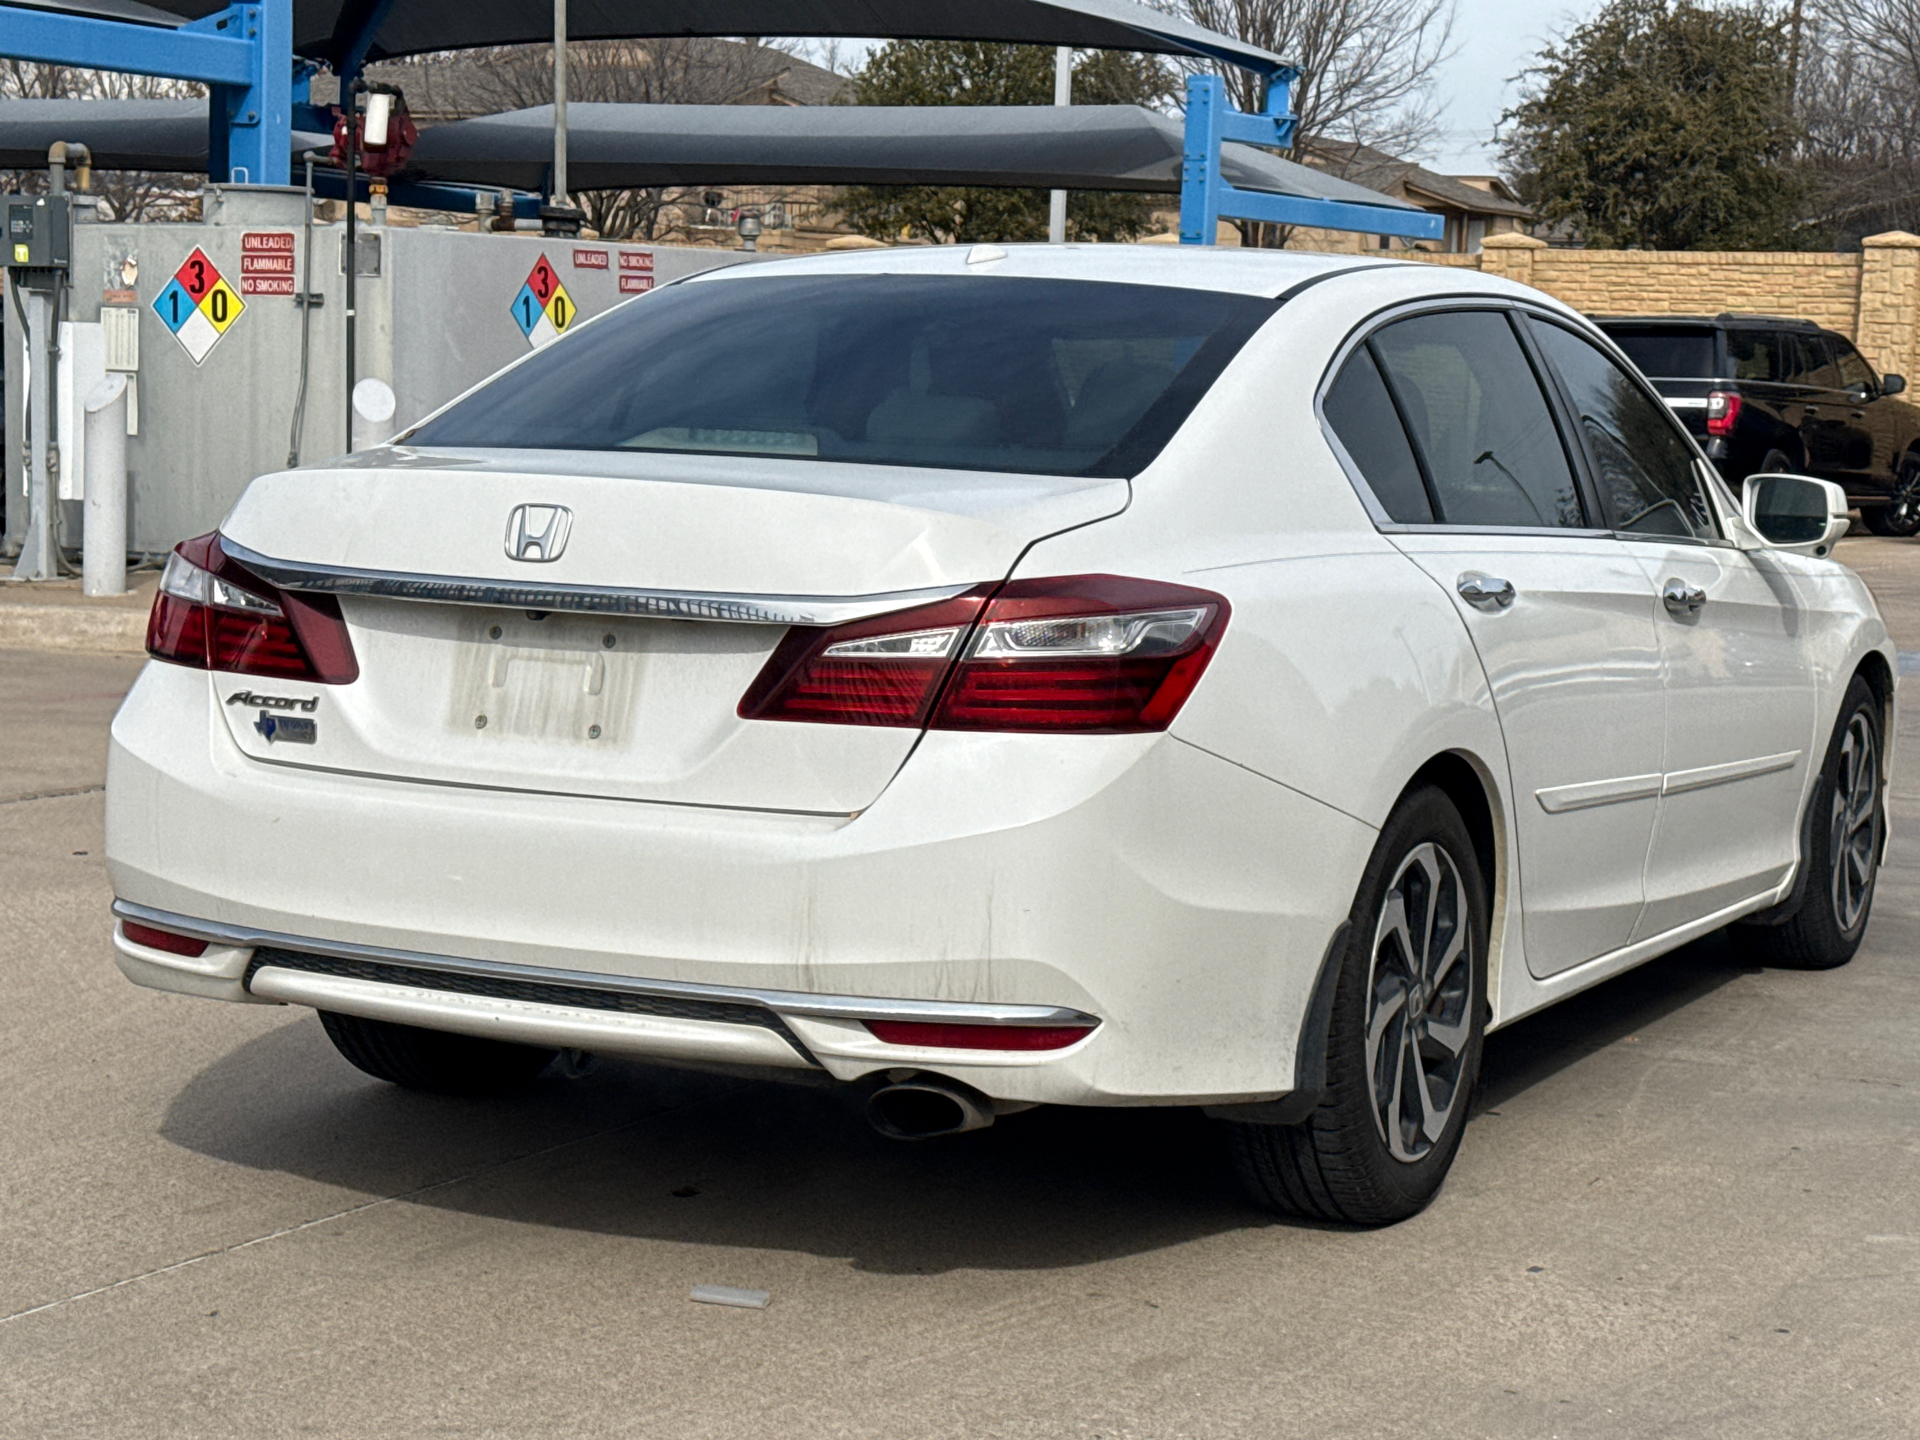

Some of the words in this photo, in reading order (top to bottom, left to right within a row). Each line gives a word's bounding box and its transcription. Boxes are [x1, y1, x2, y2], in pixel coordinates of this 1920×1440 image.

[243, 257, 293, 271] FLAMMABLE
[575, 252, 607, 266] UNLEADED
[619, 255, 628, 267] NO
[189, 260, 205, 294] 3
[242, 279, 254, 292] NO
[255, 279, 294, 293] SMOKING
[537, 266, 549, 299] 3
[169, 290, 179, 323] 1
[211, 289, 228, 323] 0
[523, 295, 531, 328] 1
[554, 296, 566, 328] 0
[225, 689, 320, 713] Accord
